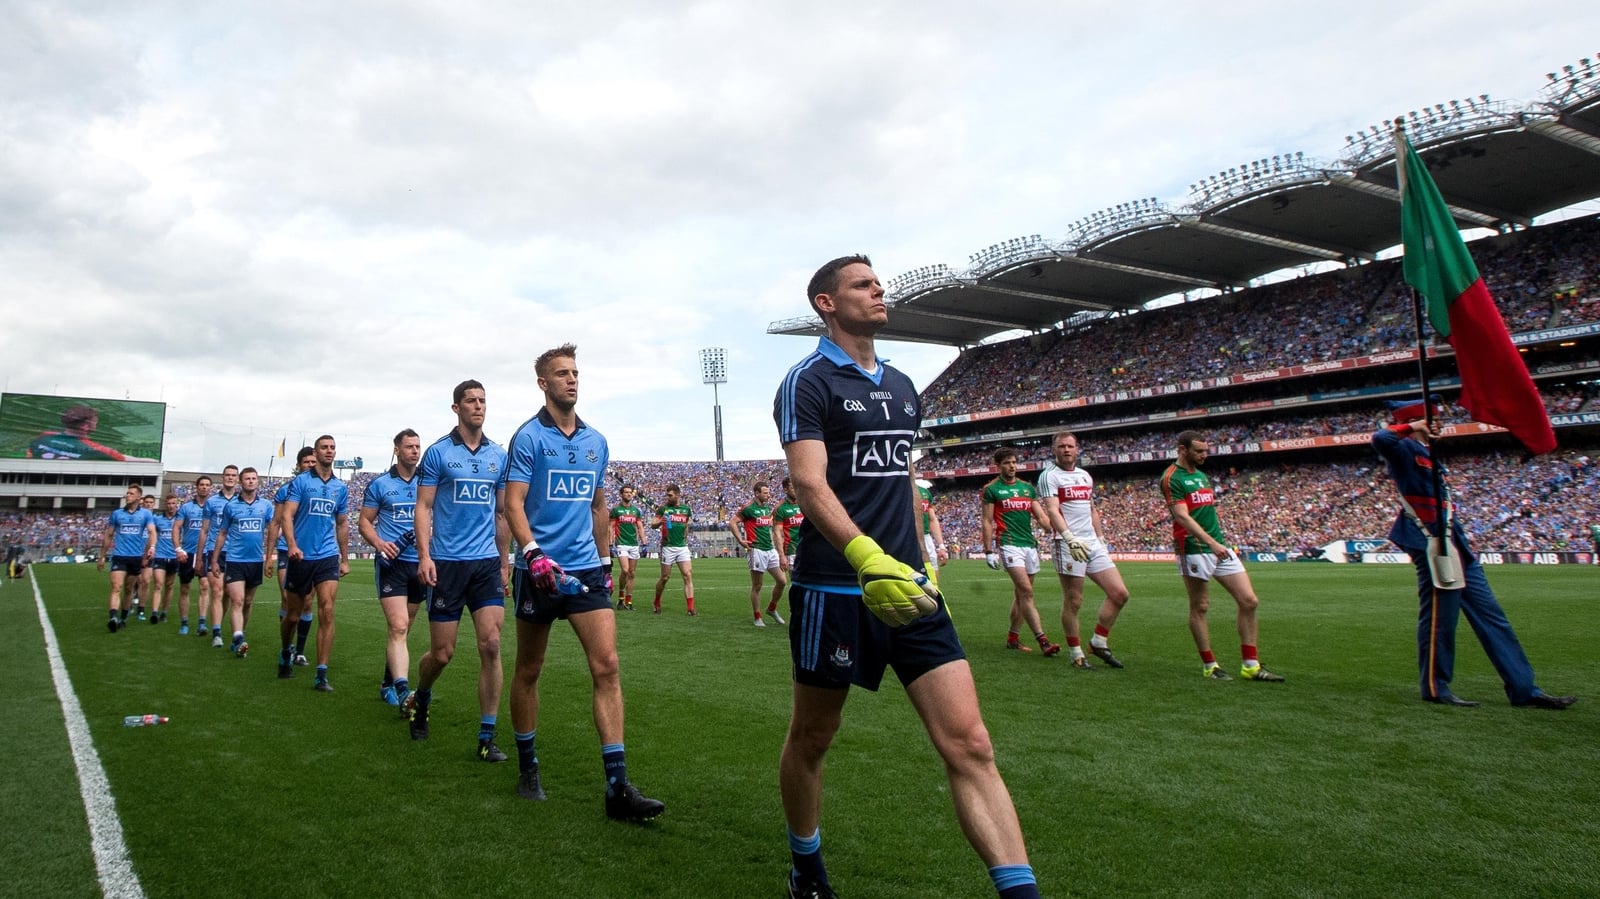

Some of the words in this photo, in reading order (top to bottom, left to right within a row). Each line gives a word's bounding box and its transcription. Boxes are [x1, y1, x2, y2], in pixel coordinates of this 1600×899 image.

[1540, 326, 1592, 340] STADIUM
[1369, 350, 1413, 364] SuperValu
[1302, 361, 1342, 373] SuperValu
[1243, 370, 1279, 381] SuperValu
[1190, 381, 1203, 391] AIB
[1216, 376, 1230, 387] AIB
[1140, 387, 1153, 397] AIB
[1164, 384, 1177, 394] AIB
[870, 391, 893, 400] O'NEILLS
[881, 401, 890, 420] 1
[1551, 416, 1582, 425] GAA
[1279, 437, 1315, 448] eircom
[1342, 433, 1372, 443] eirco
[1218, 445, 1232, 455] AIB
[1245, 442, 1260, 452] AIB
[568, 452, 576, 464] 2
[861, 439, 911, 467] AIG
[1141, 451, 1153, 461] AIB
[472, 463, 479, 474] 3
[459, 483, 489, 500] AIG
[553, 477, 591, 495] AIG
[312, 501, 333, 514] AIG
[241, 520, 260, 530] AIG
[1479, 553, 1504, 564] AIB
[1534, 553, 1560, 564] AIB
